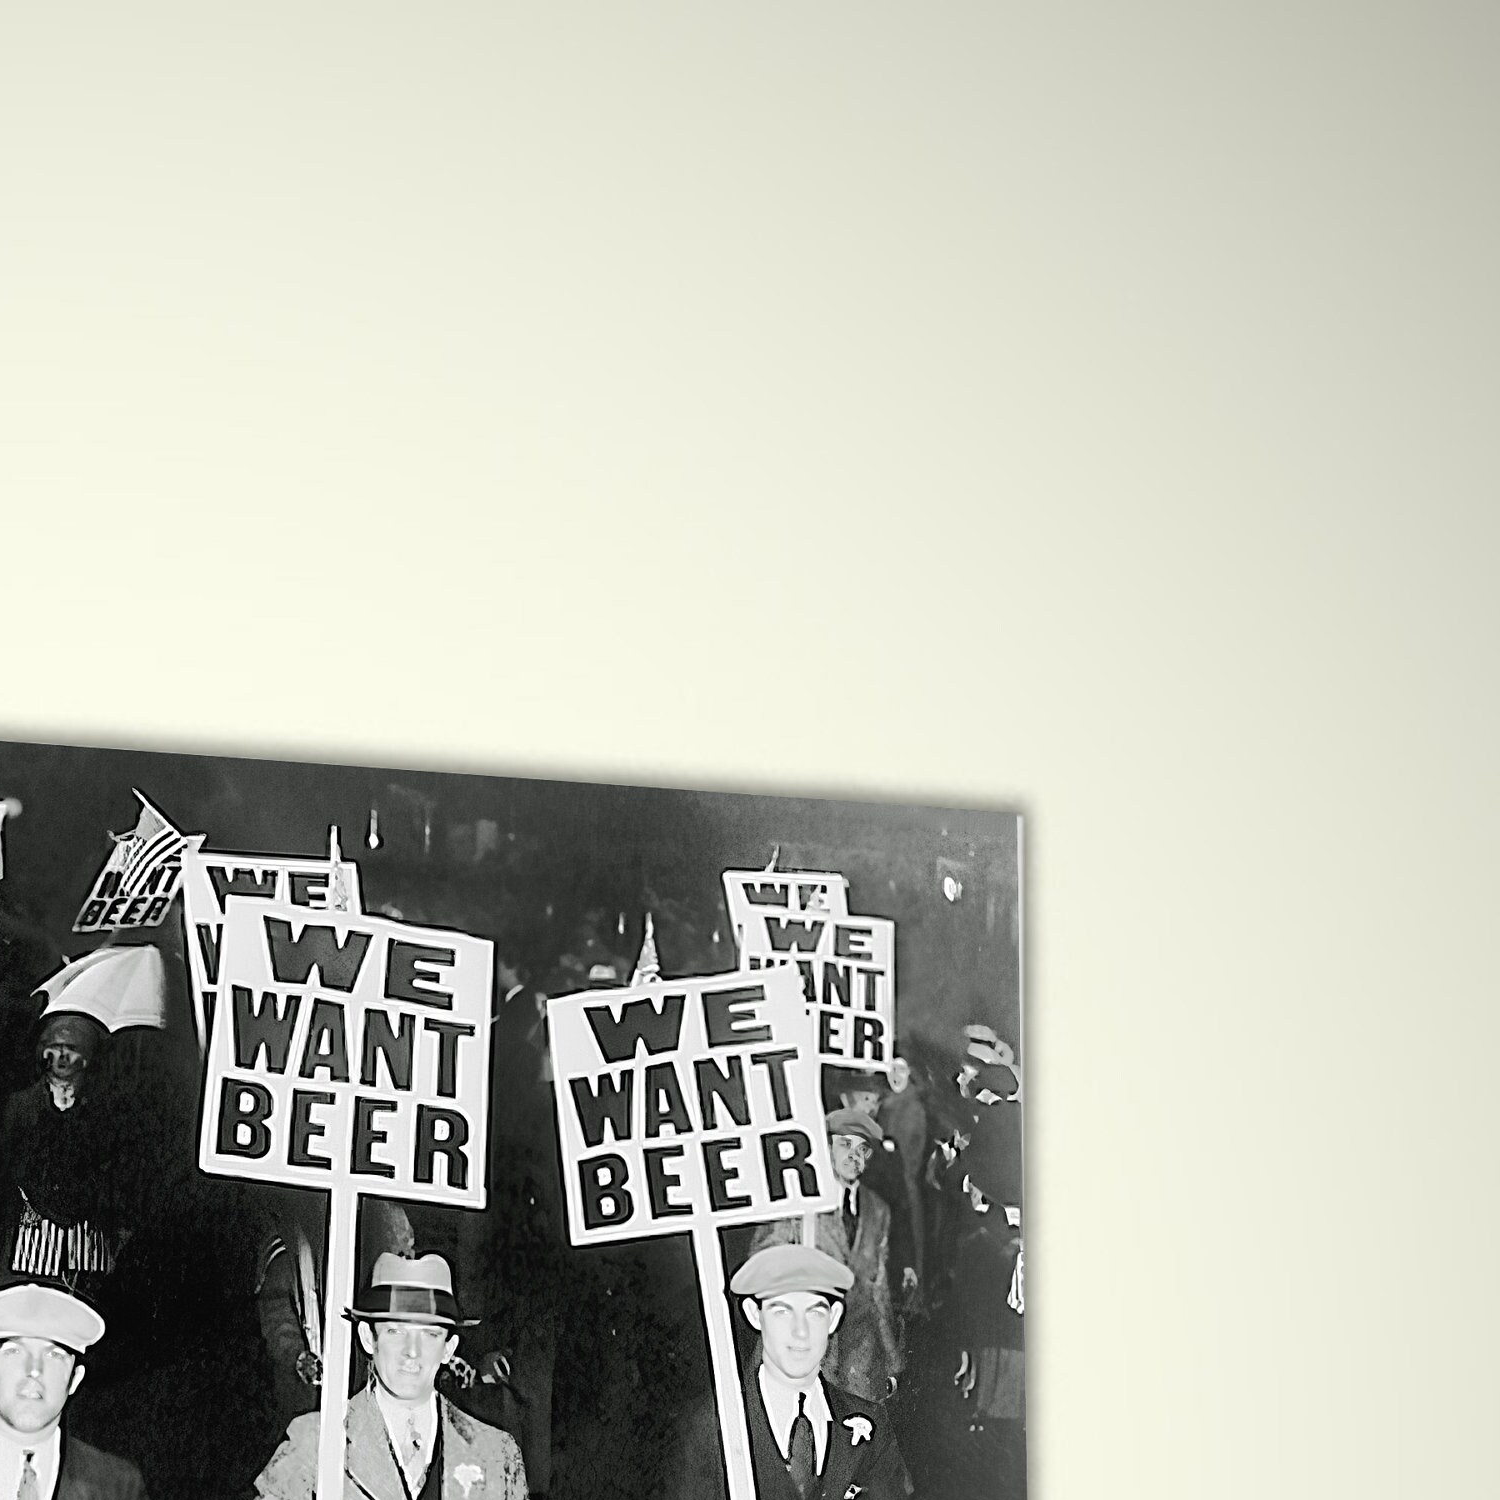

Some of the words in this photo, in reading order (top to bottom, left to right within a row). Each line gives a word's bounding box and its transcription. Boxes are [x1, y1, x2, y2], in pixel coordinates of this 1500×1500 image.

[78, 896, 171, 926] BEER
[96, 864, 182, 899] WNT
[263, 914, 457, 1010] WE
[764, 916, 873, 961] WE
[583, 984, 774, 1064] WE
[750, 956, 884, 1012] ANT
[231, 984, 476, 1099] WANT
[818, 1010, 885, 1062] ER
[215, 1076, 471, 1190] BEER
[568, 1046, 799, 1149] WANT
[577, 1129, 821, 1230] BEER
